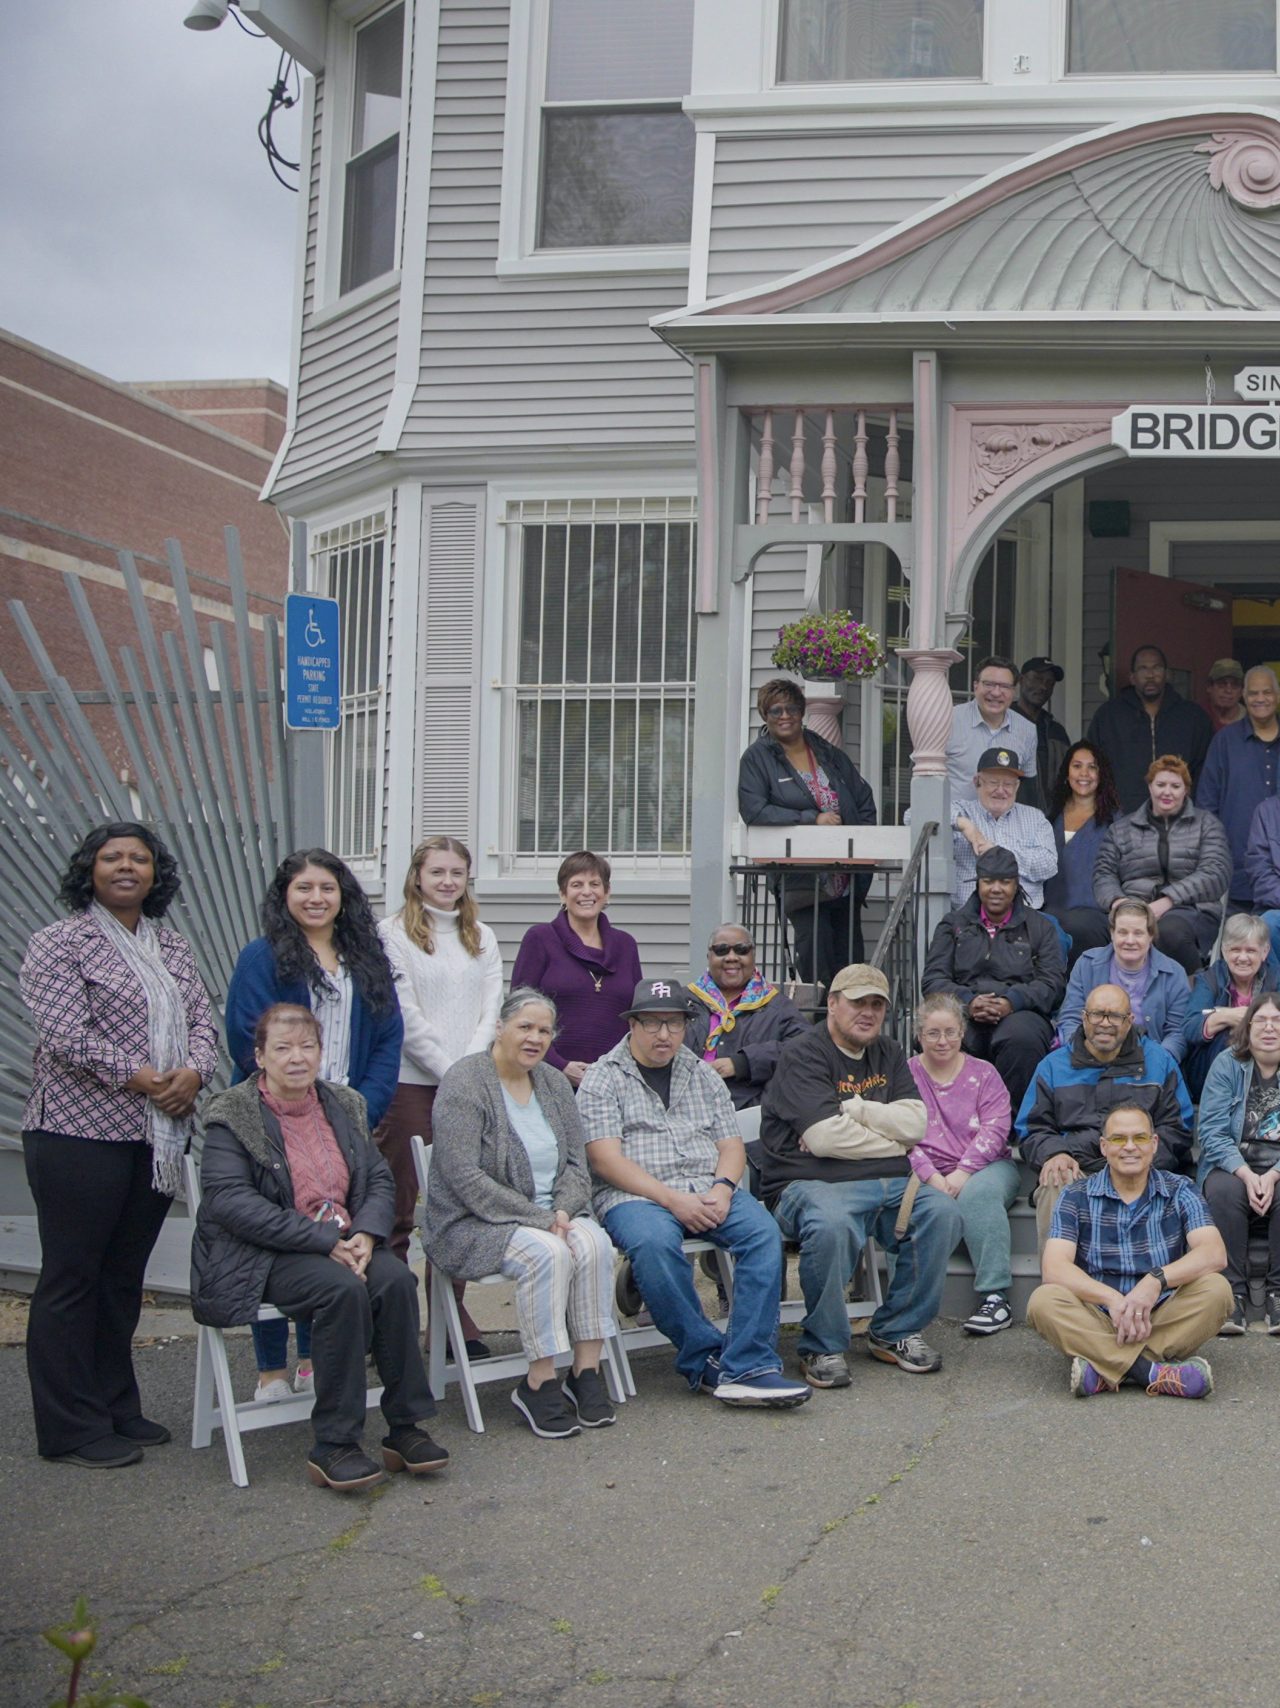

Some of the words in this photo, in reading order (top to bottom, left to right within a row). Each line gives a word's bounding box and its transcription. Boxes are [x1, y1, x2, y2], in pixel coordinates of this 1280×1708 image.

[297, 655, 331, 668] HANDICAPPED
[302, 669, 326, 682] PARKING
[297, 694, 311, 704] PERMIT
[312, 695, 333, 705] REQUIRED
